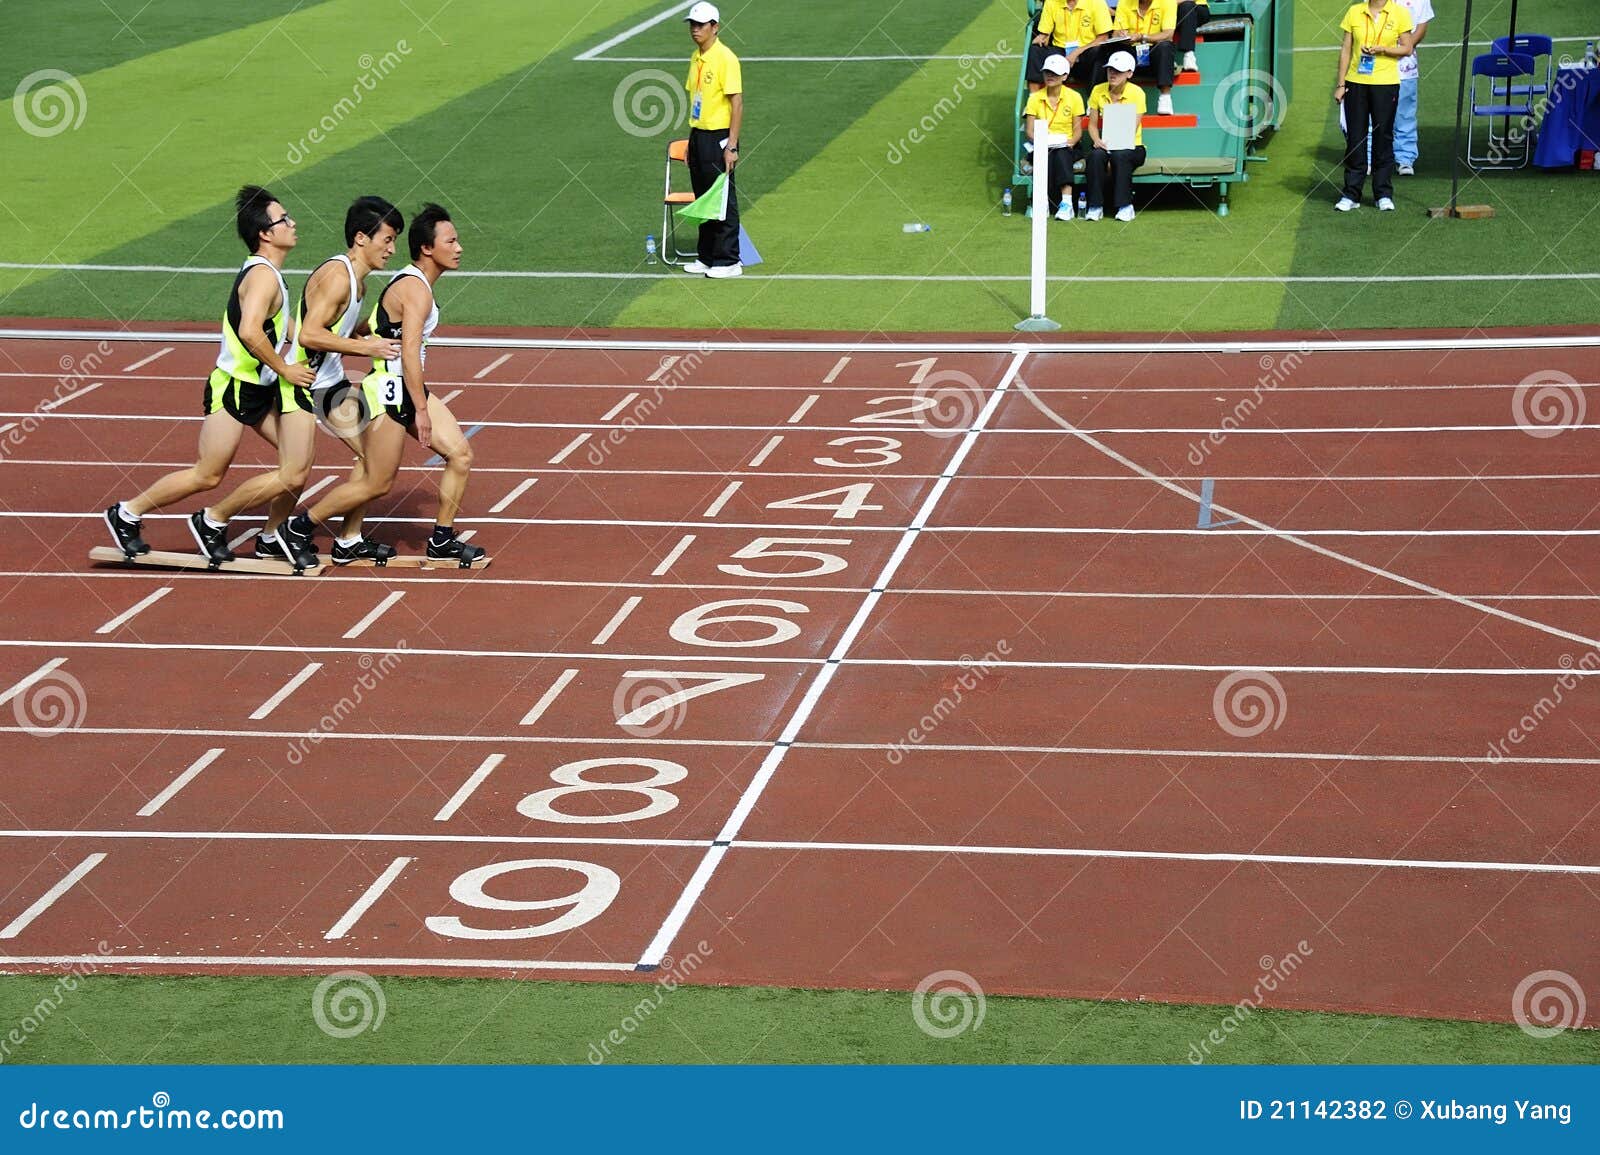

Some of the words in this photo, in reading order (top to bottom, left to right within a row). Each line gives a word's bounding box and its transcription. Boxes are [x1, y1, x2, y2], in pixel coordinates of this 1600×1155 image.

[896, 357, 939, 384] 1
[385, 380, 395, 402] 3
[850, 395, 938, 424] 2
[814, 435, 903, 468] 3
[766, 483, 883, 519] 4
[717, 537, 852, 579] 5
[668, 599, 809, 648] 6
[616, 670, 765, 725] 7
[516, 757, 689, 824] 8
[425, 858, 620, 940] 9
